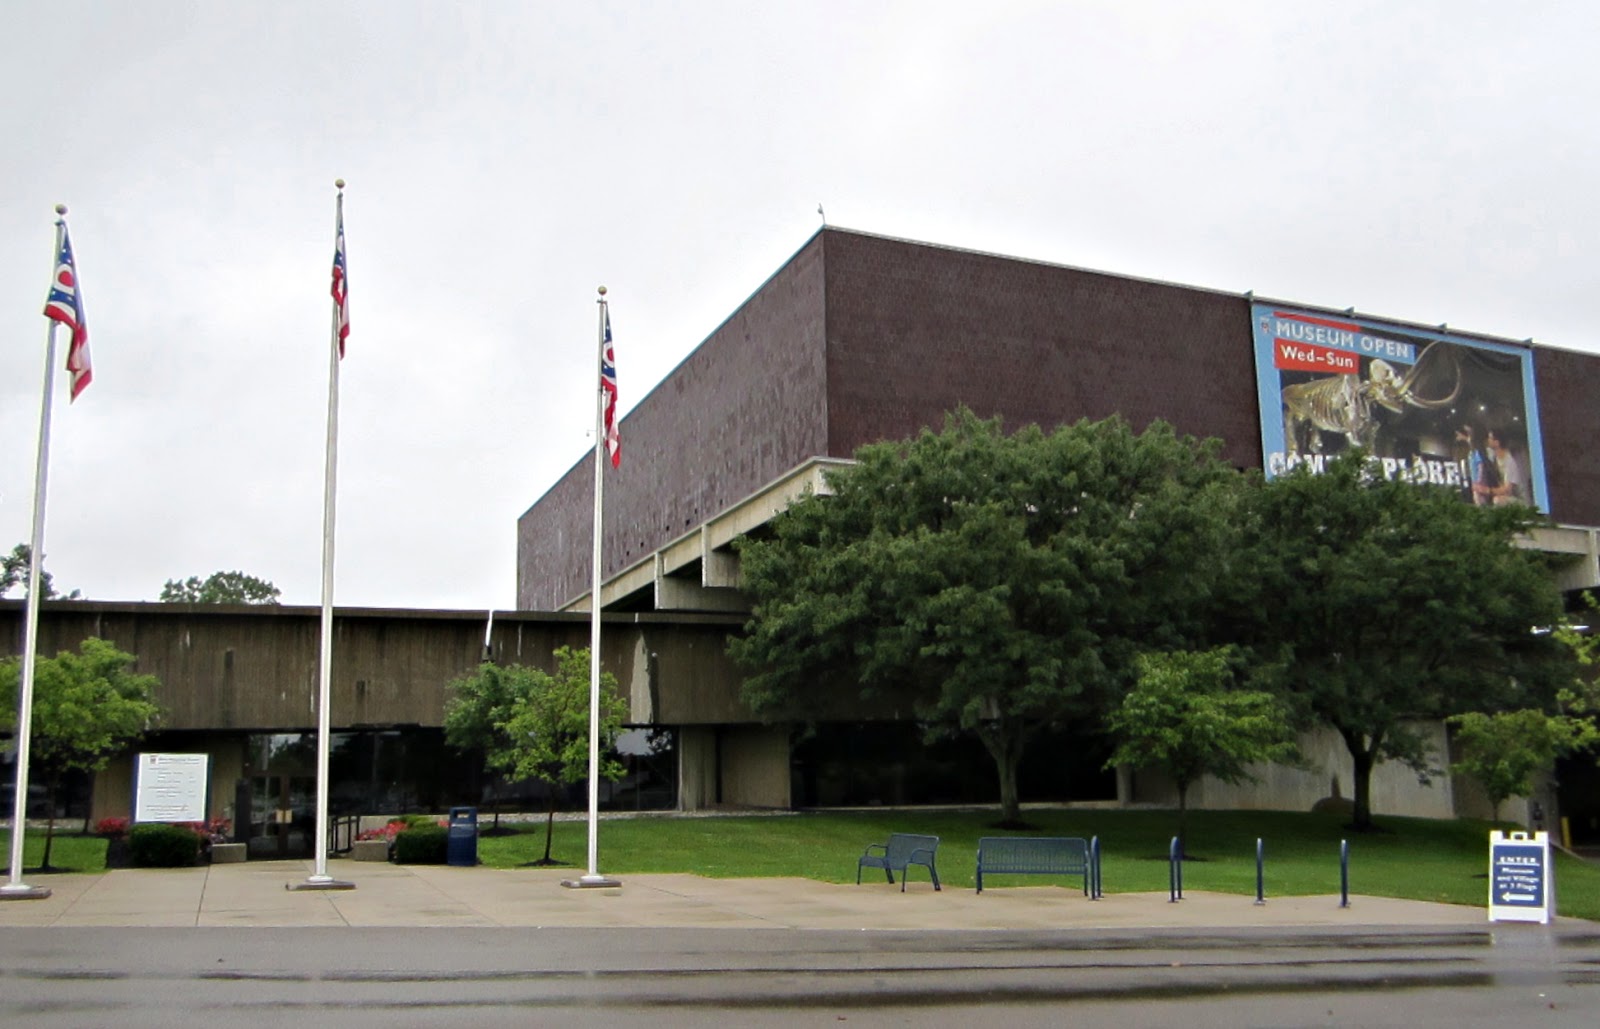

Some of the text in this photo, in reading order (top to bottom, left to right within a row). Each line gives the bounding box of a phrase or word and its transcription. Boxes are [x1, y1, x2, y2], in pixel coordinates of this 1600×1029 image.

[1276, 320, 1409, 359] MUSEUM OPEN
[1280, 344, 1354, 368] Wed-Sun
[1269, 452, 1341, 477] COM
